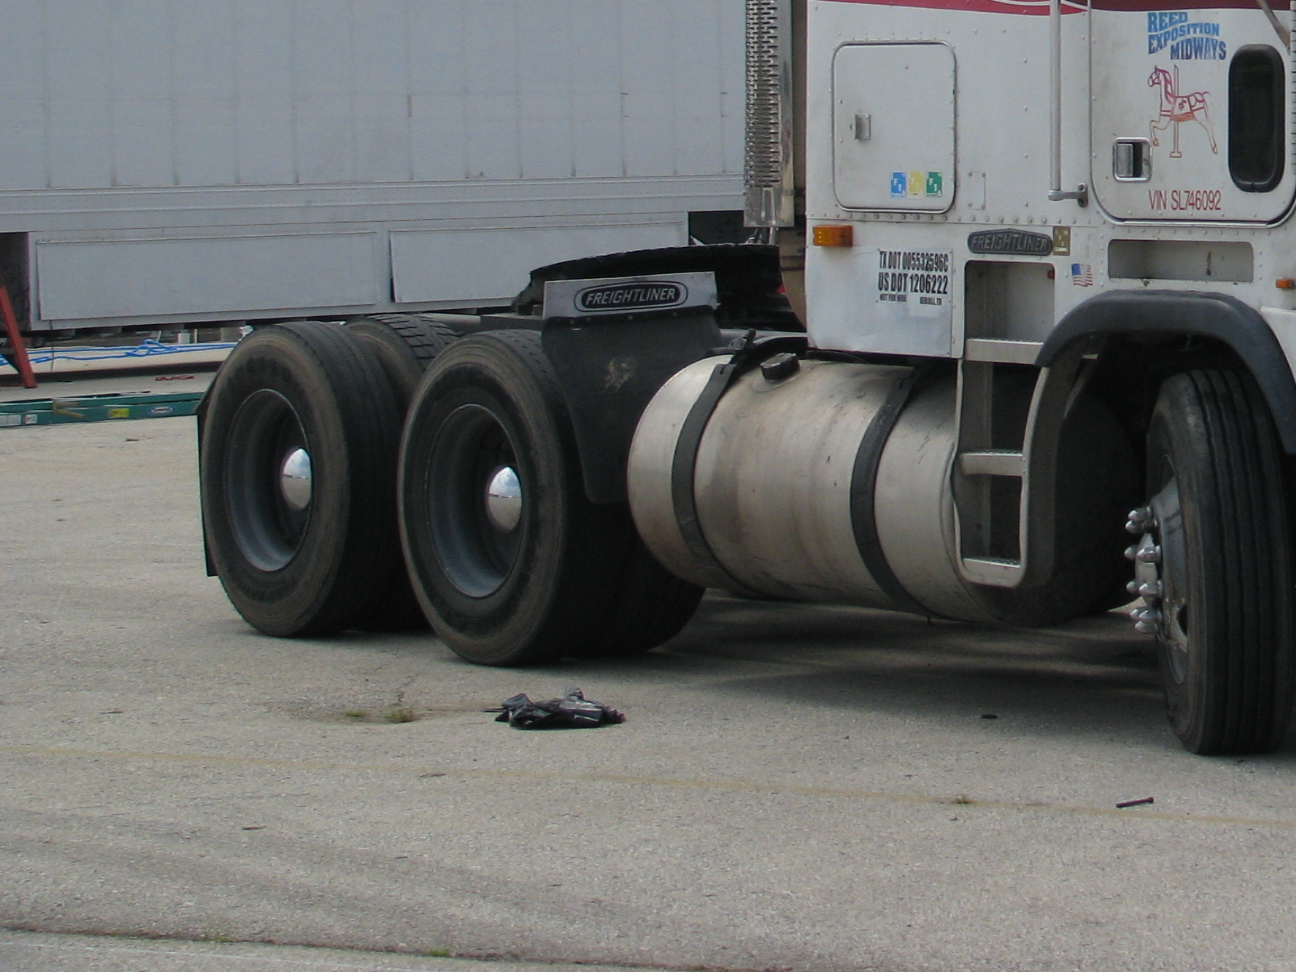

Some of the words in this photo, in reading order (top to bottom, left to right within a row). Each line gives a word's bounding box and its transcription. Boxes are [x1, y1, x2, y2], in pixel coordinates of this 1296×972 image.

[1147, 12, 1189, 33] REED
[1148, 23, 1220, 55] EXPOSITION
[1170, 36, 1227, 60] MIDWAYS
[1148, 190, 1167, 210] VIN
[1170, 190, 1222, 210] SL746092
[971, 233, 1049, 252] FREIGHTLINER
[879, 251, 887, 269] TX
[888, 251, 901, 269] DOT
[878, 272, 889, 291] US
[891, 273, 908, 292] DOT
[909, 274, 948, 294] 1206222
[585, 288, 676, 306] FREIGHTLINER
